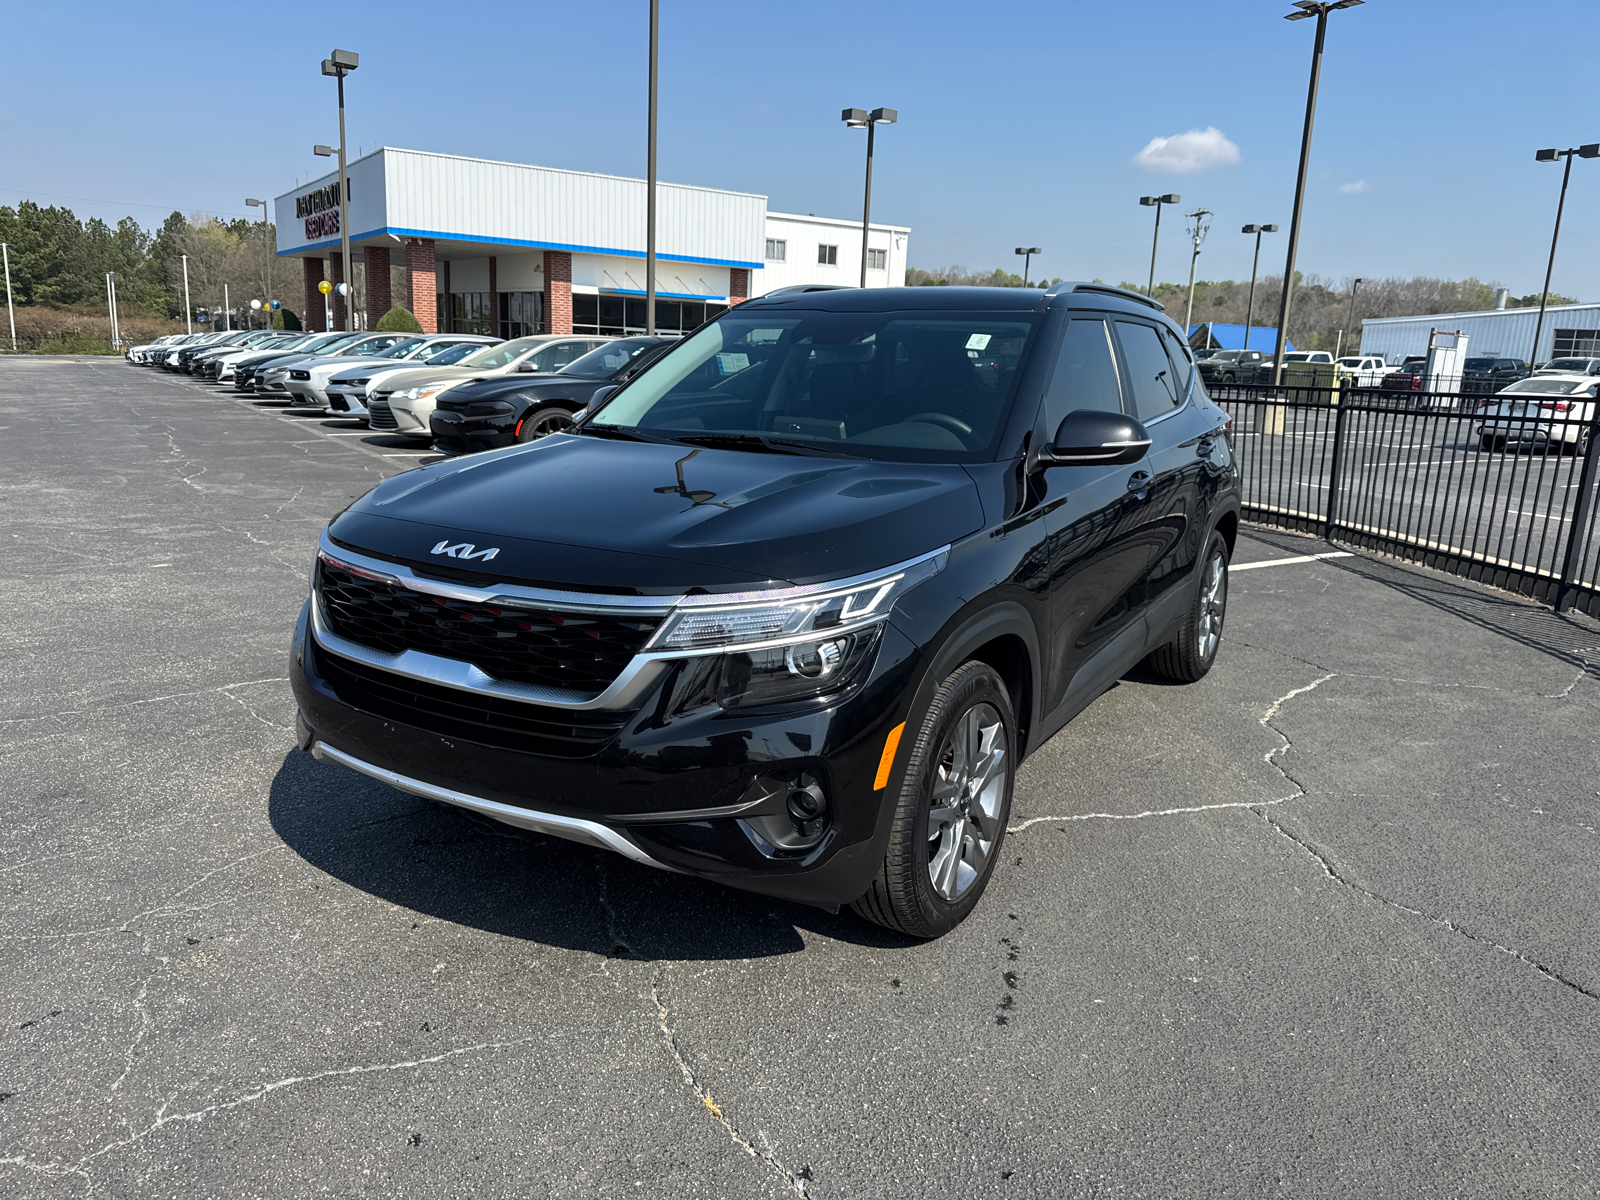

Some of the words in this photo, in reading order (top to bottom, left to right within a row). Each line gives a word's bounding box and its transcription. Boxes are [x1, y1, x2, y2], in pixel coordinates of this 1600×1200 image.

[296, 194, 312, 218] JOHN
[312, 178, 350, 213] THORNTO
[305, 216, 320, 239] USED
[320, 210, 339, 235] CARS
[430, 540, 500, 562] KIA
